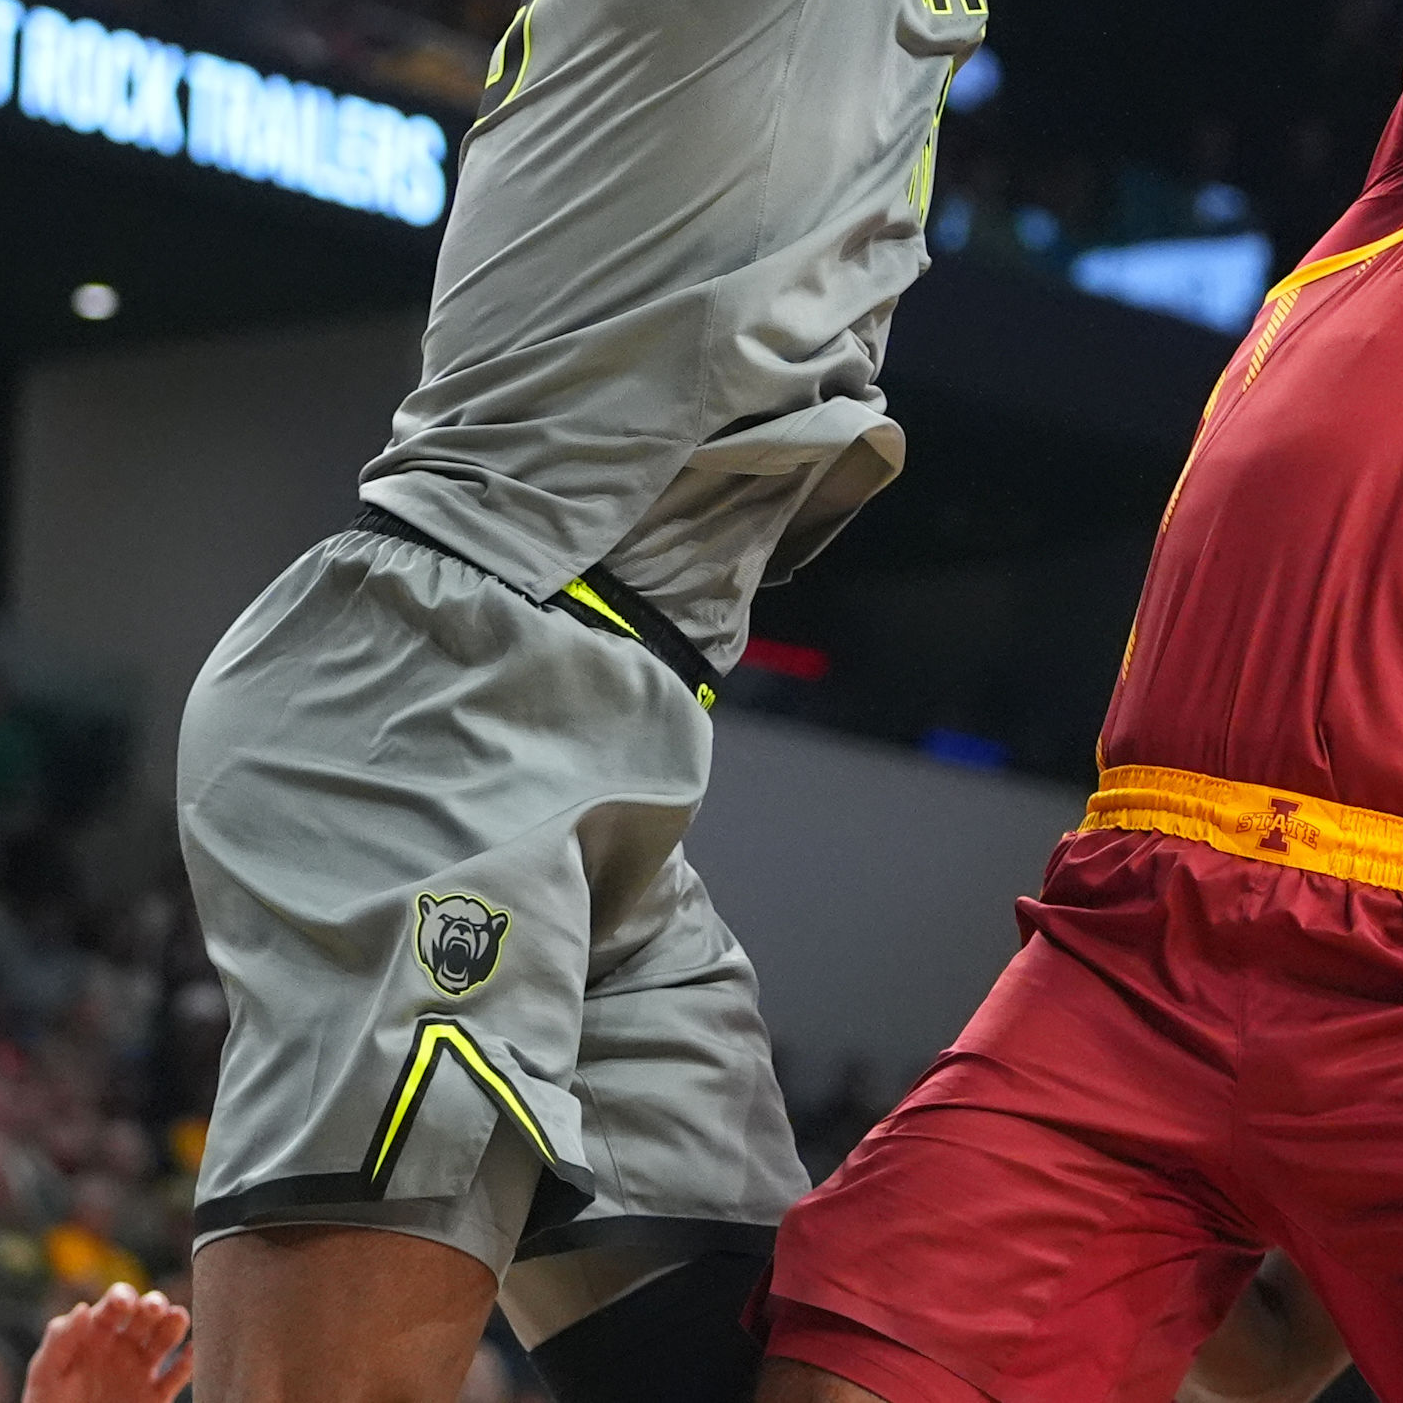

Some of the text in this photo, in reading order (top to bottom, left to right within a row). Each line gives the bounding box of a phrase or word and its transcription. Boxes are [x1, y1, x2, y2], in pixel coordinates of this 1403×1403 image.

[19, 6, 187, 156] ROCK
[188, 51, 447, 227] TRAILERS
[1235, 811, 1321, 851] STATE
